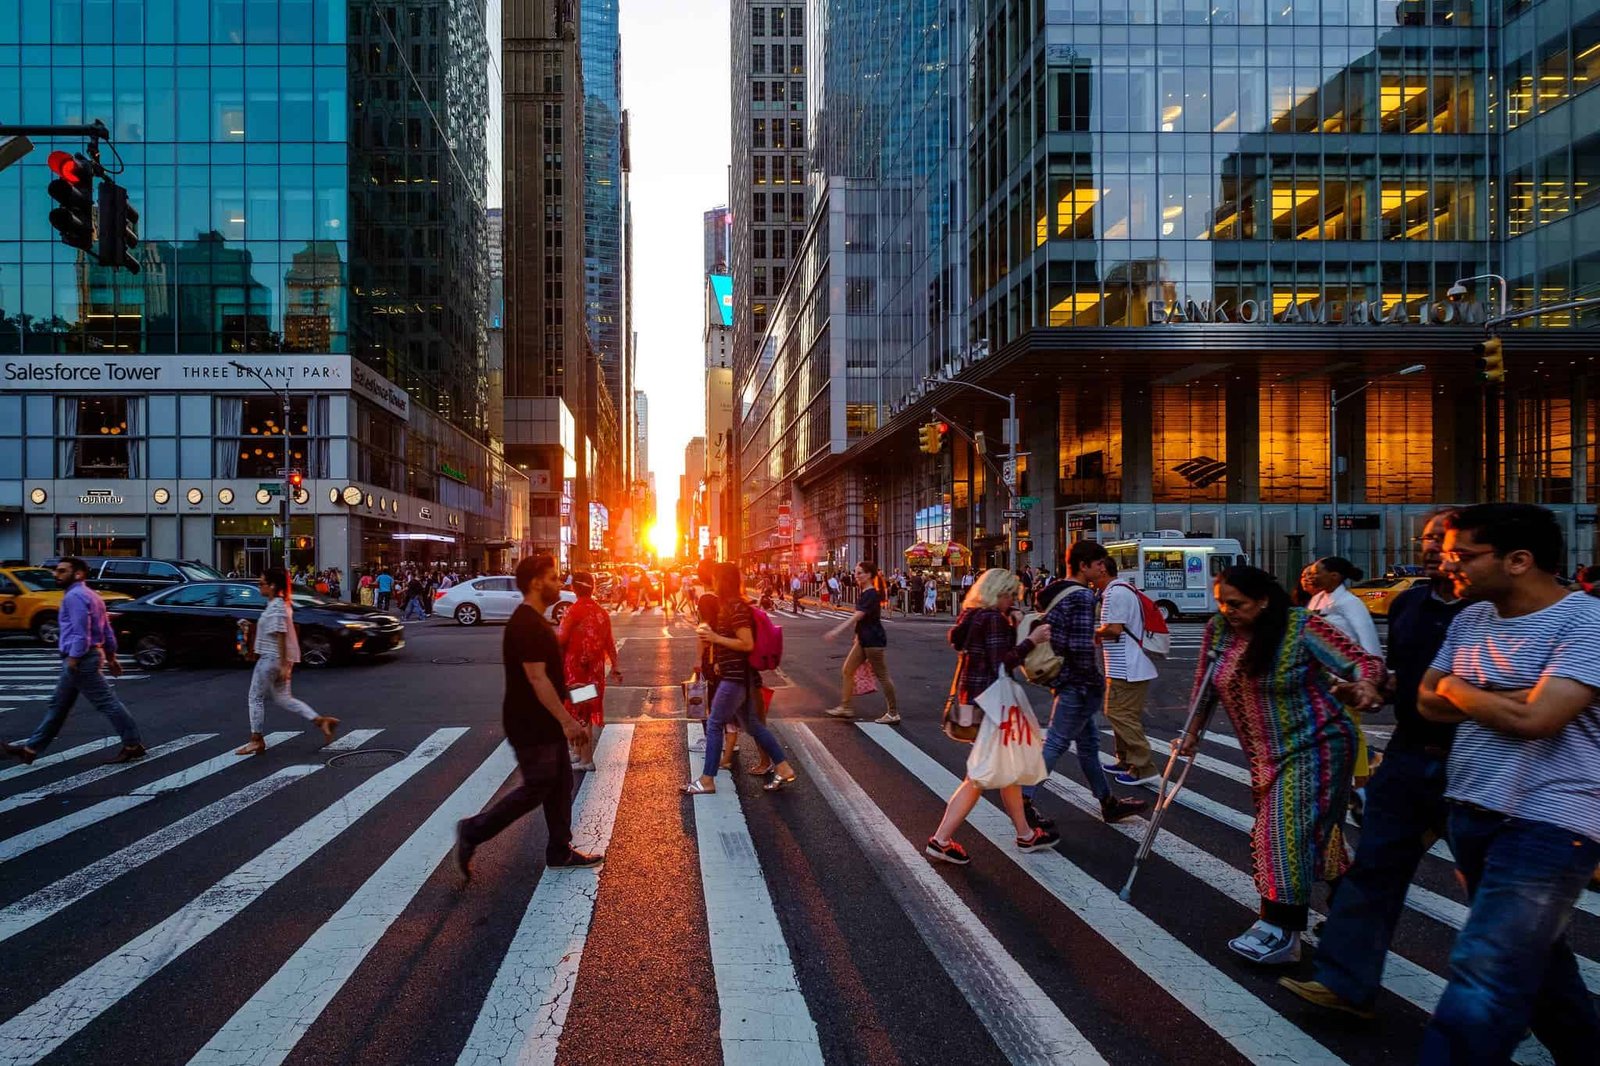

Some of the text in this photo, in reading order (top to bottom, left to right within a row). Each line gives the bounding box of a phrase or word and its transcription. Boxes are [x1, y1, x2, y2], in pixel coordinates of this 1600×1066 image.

[1147, 299, 1230, 323] BANK
[1238, 298, 1272, 322] OF
[1281, 299, 1410, 323] AMERICA
[5, 363, 161, 380] Salesforce Tower
[182, 366, 229, 378] THREE
[236, 366, 295, 378] BRYANT
[354, 366, 389, 401] Saesforce
